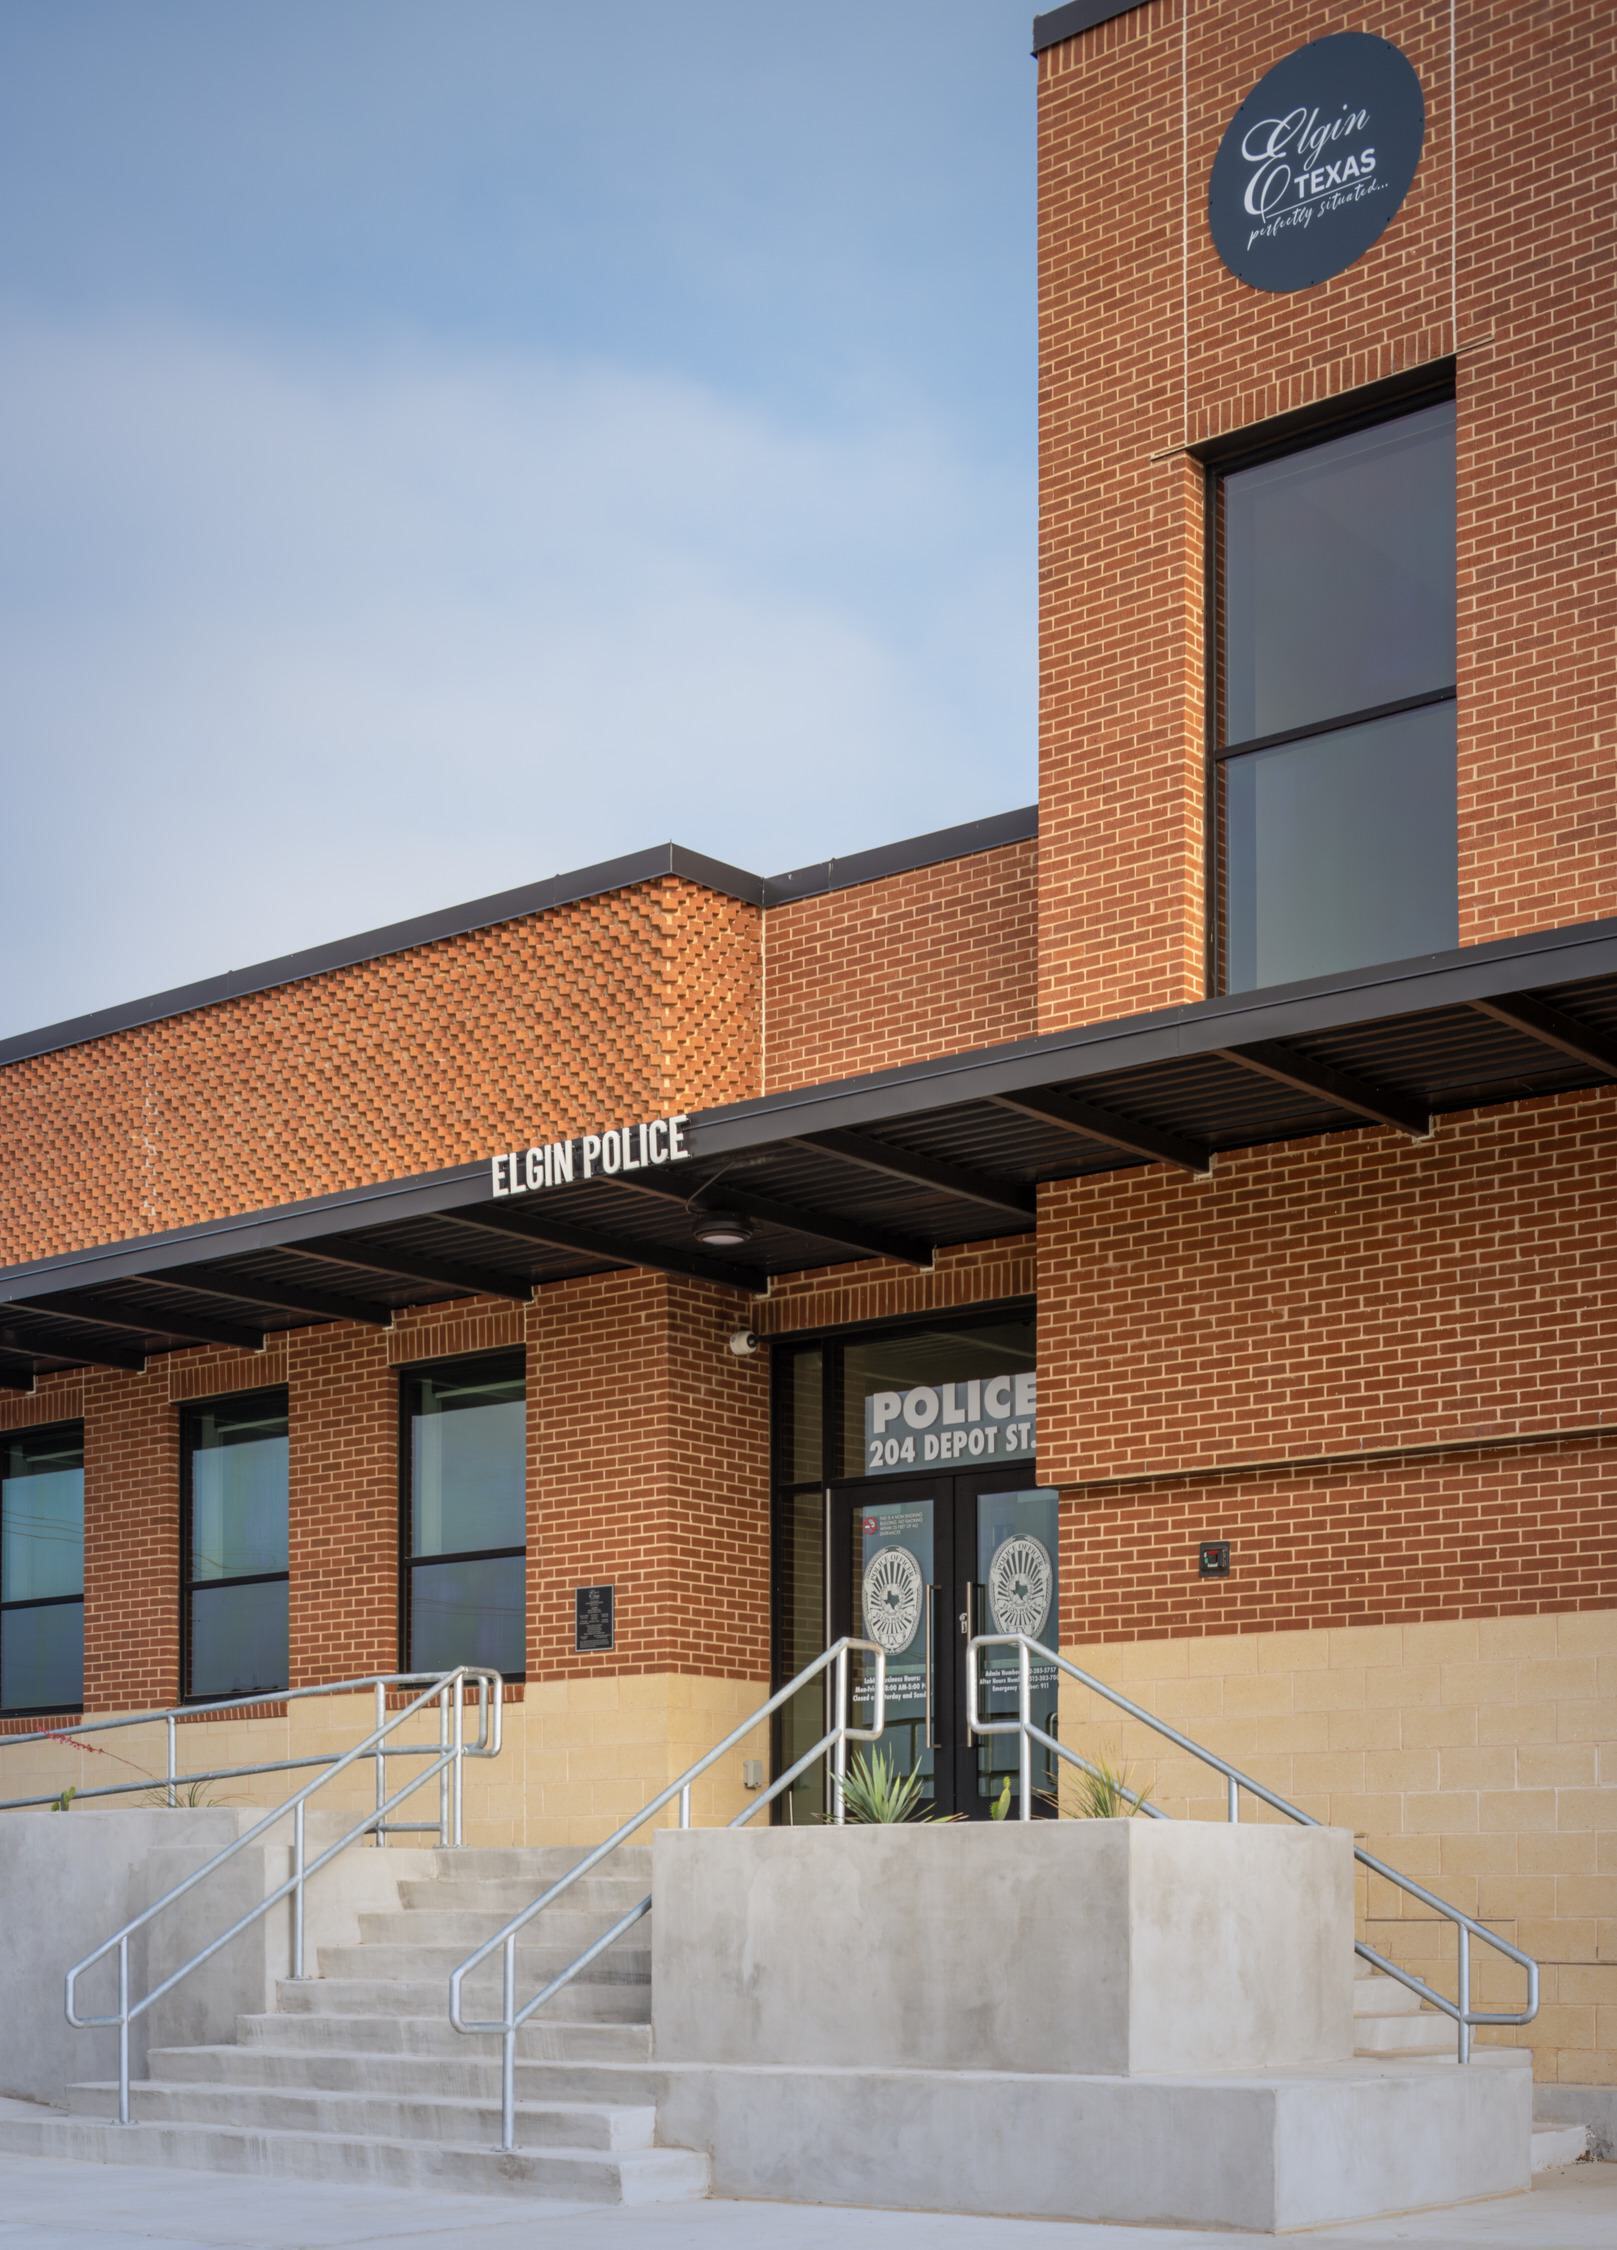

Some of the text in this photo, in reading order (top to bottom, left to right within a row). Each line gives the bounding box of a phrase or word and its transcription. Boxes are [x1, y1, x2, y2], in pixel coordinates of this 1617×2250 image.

[1294, 148, 1376, 199] TEXAS
[1247, 178, 1389, 251] perfectly situated...
[492, 1114, 690, 1198] ELGIN POLICE
[873, 1372, 1036, 1434] POLICE
[869, 1422, 1036, 1468] 204 DEPOT ST.
[870, 1554, 914, 1581] POLICE OFFICER
[996, 1543, 1043, 1570] POLICE OFFICER
[852, 1694, 870, 1702] Closed
